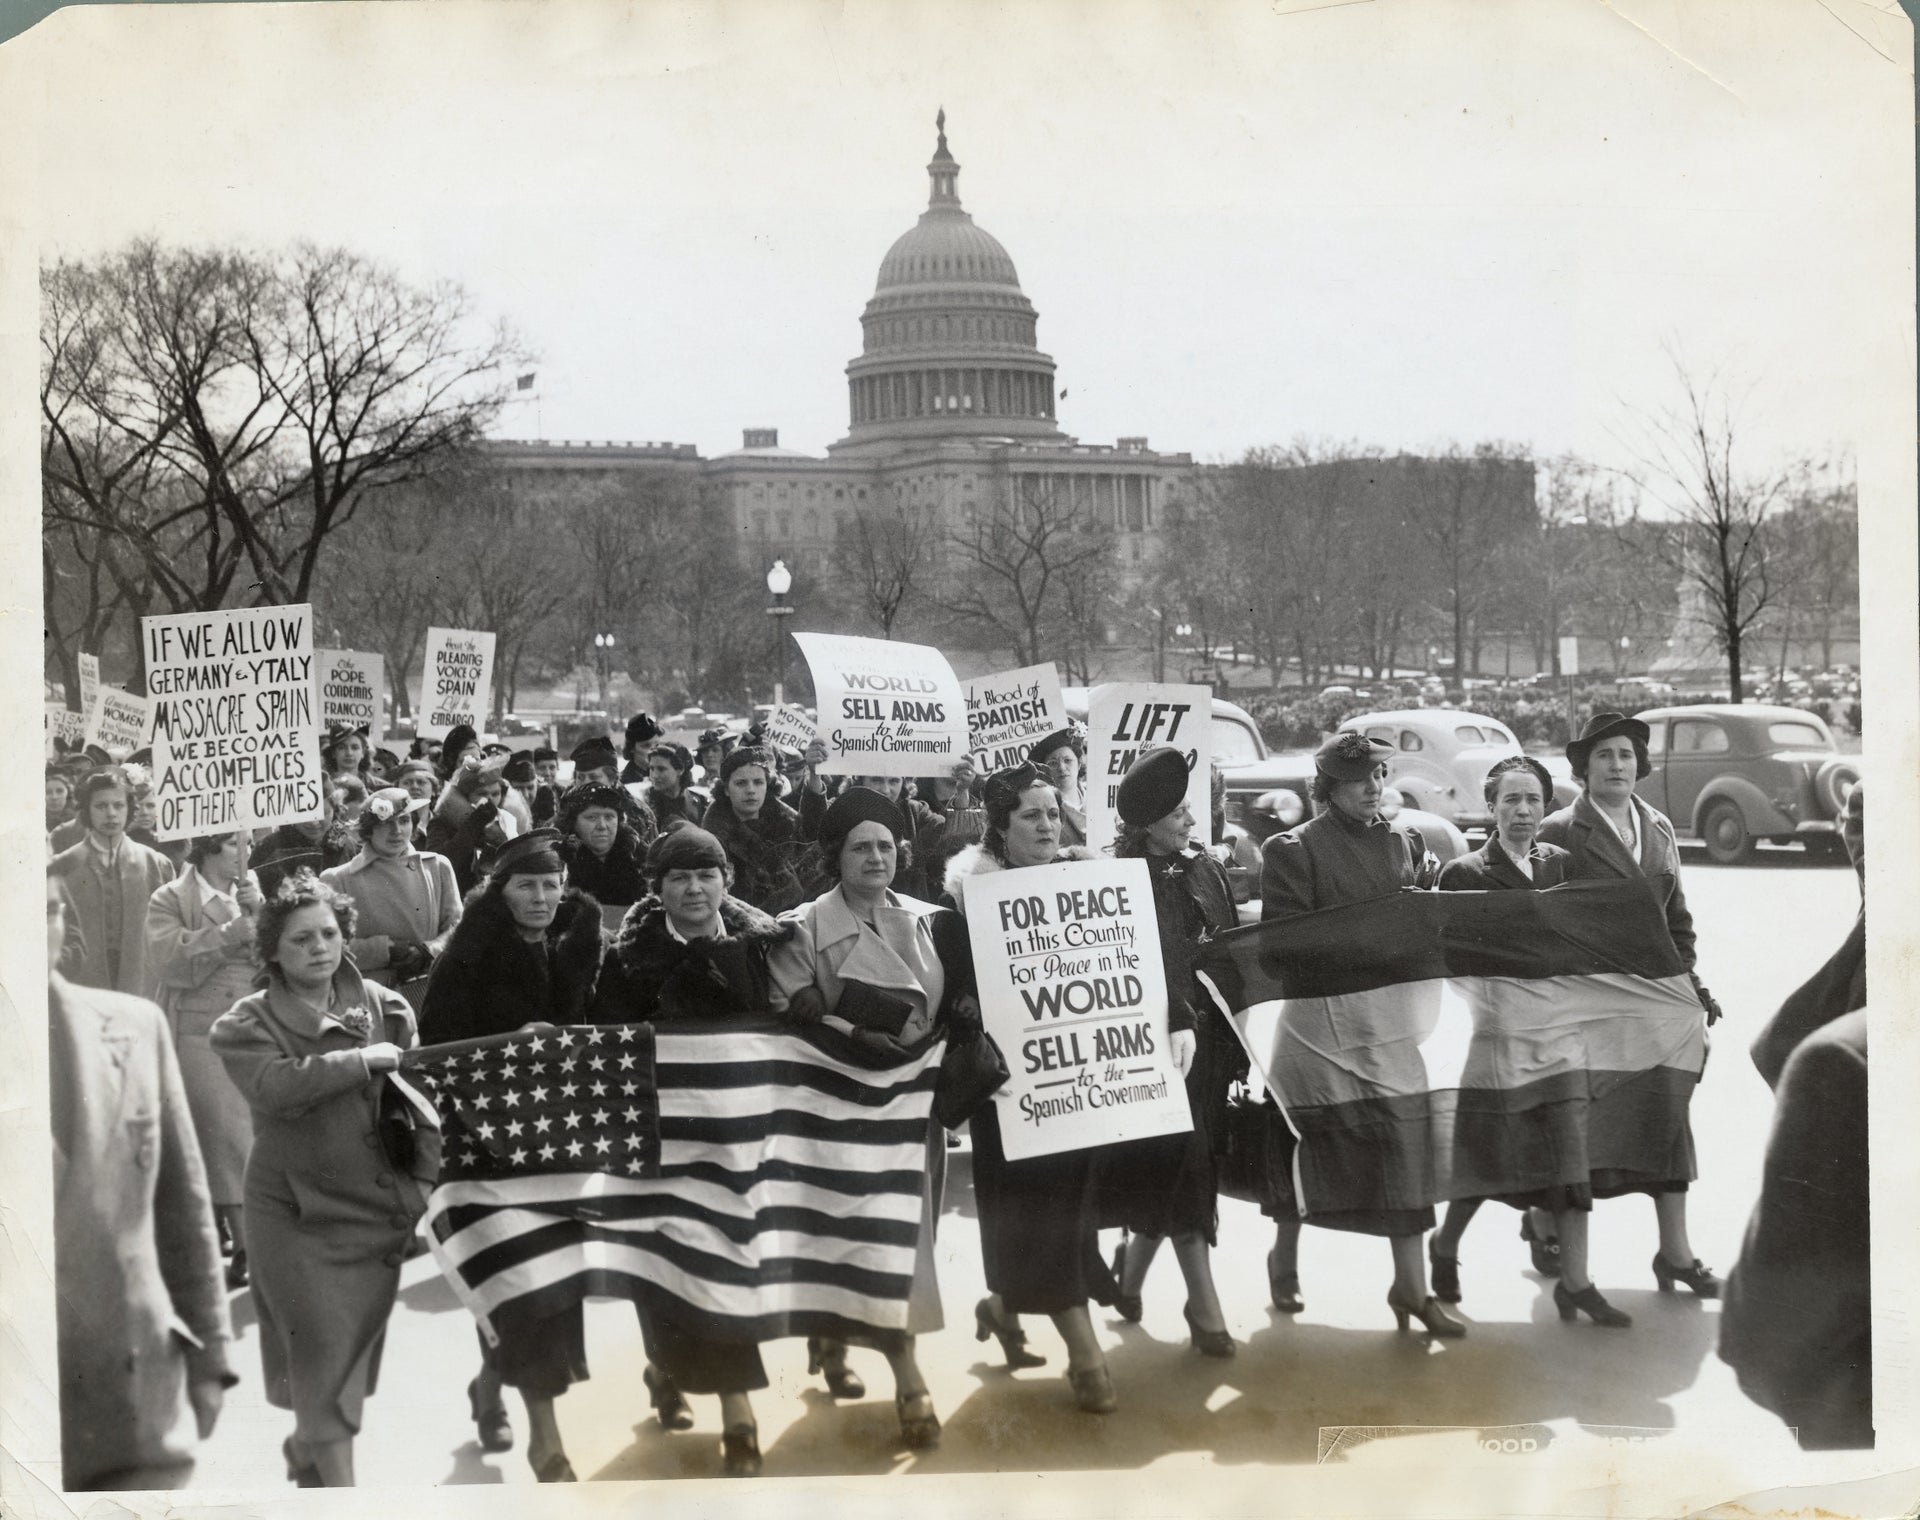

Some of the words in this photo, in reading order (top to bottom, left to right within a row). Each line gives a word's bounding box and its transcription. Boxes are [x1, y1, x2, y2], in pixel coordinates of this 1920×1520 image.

[151, 627, 172, 662] IF
[177, 624, 216, 660] WE
[222, 617, 303, 656] ALLOW
[437, 651, 483, 667] PLEADING
[437, 666, 467, 679] VOICE
[469, 667, 482, 680] OF
[150, 662, 233, 694] GERMANY
[248, 655, 312, 685] YTALY
[331, 669, 366, 684] POPE
[436, 680, 476, 696] SPAIN
[841, 672, 938, 694] WORLD
[324, 683, 373, 700] CONDEMNS
[983, 683, 1022, 706] Blood
[1027, 680, 1040, 701] of
[103, 706, 145, 728] WOMEN
[150, 693, 248, 745] MASSACRE
[256, 687, 312, 732] SPAIN
[324, 701, 373, 718] FRANCOS
[430, 712, 475, 727] EMBARGO
[777, 707, 817, 739] MOTHER
[842, 697, 885, 721] SELL
[891, 700, 946, 723] ARMS
[967, 697, 1048, 732] SPANISH
[1111, 703, 1191, 742] LIFT
[97, 729, 138, 751] WOMEN
[831, 728, 879, 757] Spanish
[881, 732, 952, 754] Government
[875, 722, 890, 736] to
[896, 722, 914, 737] the
[1014, 720, 1054, 738] Children
[170, 743, 198, 761] WE
[204, 731, 299, 759] BECOME
[158, 751, 305, 796] ACCOMPLICES
[162, 797, 183, 831] OF
[189, 790, 238, 828] THEIR
[253, 780, 319, 818] CRIMES
[998, 896, 1051, 932] FOR
[1056, 886, 1132, 923] PEACE
[1006, 937, 1023, 956] in
[1028, 928, 1061, 951] this
[1009, 963, 1037, 985] For
[1043, 954, 1091, 980] Peace
[1097, 951, 1113, 972] in
[1116, 945, 1141, 970] the
[1020, 974, 1143, 1021] WORLD
[1022, 1032, 1088, 1074] SELL
[1096, 1022, 1155, 1062] ARMS
[1076, 1067, 1095, 1087] to
[1104, 1062, 1125, 1082] the
[1019, 1085, 1084, 1127] Spanish
[1087, 1072, 1169, 1108] Government
